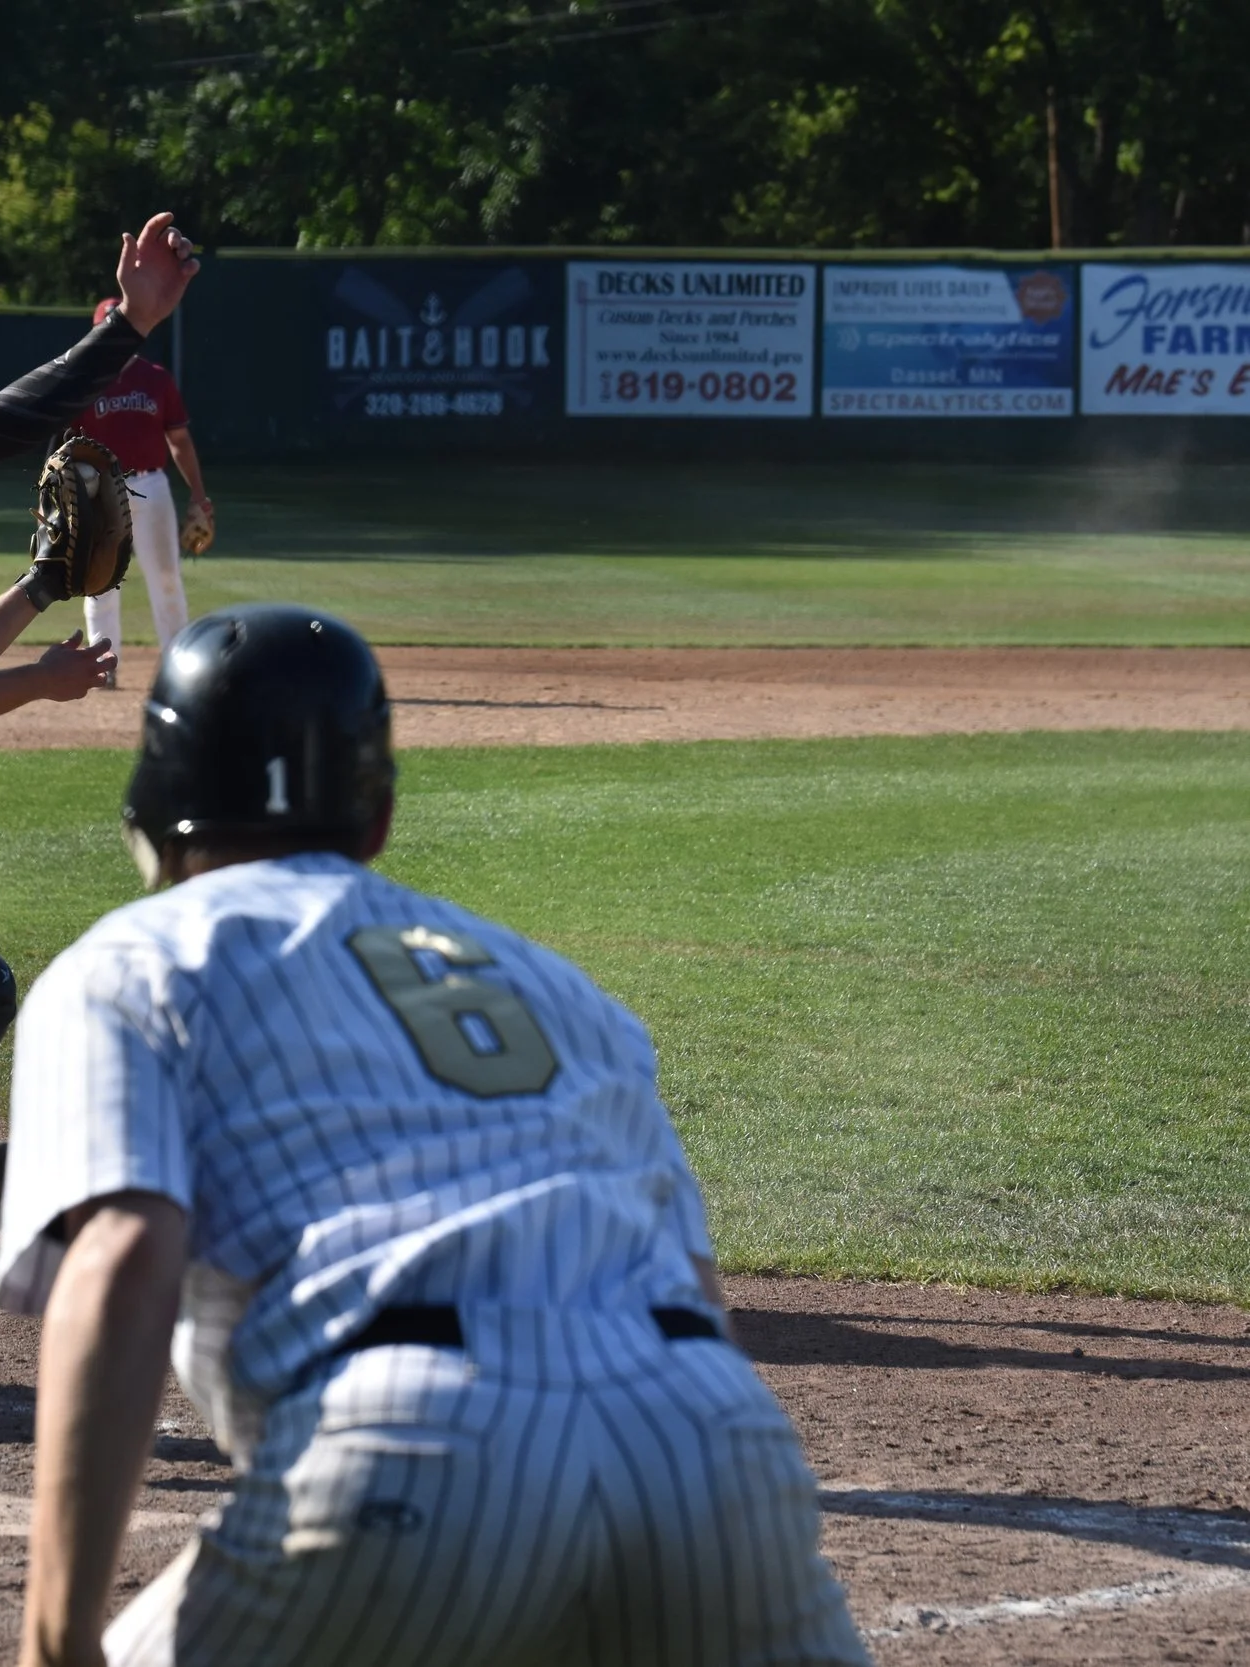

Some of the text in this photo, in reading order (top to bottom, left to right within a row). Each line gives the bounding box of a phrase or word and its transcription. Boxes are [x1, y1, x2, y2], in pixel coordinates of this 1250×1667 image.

[597, 271, 805, 297] DECKS UNLIMITED
[599, 308, 797, 327] Custom Decks and Porches
[327, 325, 550, 369] BAIT & HOOK
[659, 331, 699, 343] Since
[616, 370, 797, 402] 819-0802
[968, 368, 1004, 384] MN
[1104, 363, 1215, 397] MAE'S
[95, 390, 158, 418] Devils
[830, 392, 1066, 411] SPECTRALYTICS.COM
[265, 755, 289, 815] 1
[346, 924, 562, 1099] 6
